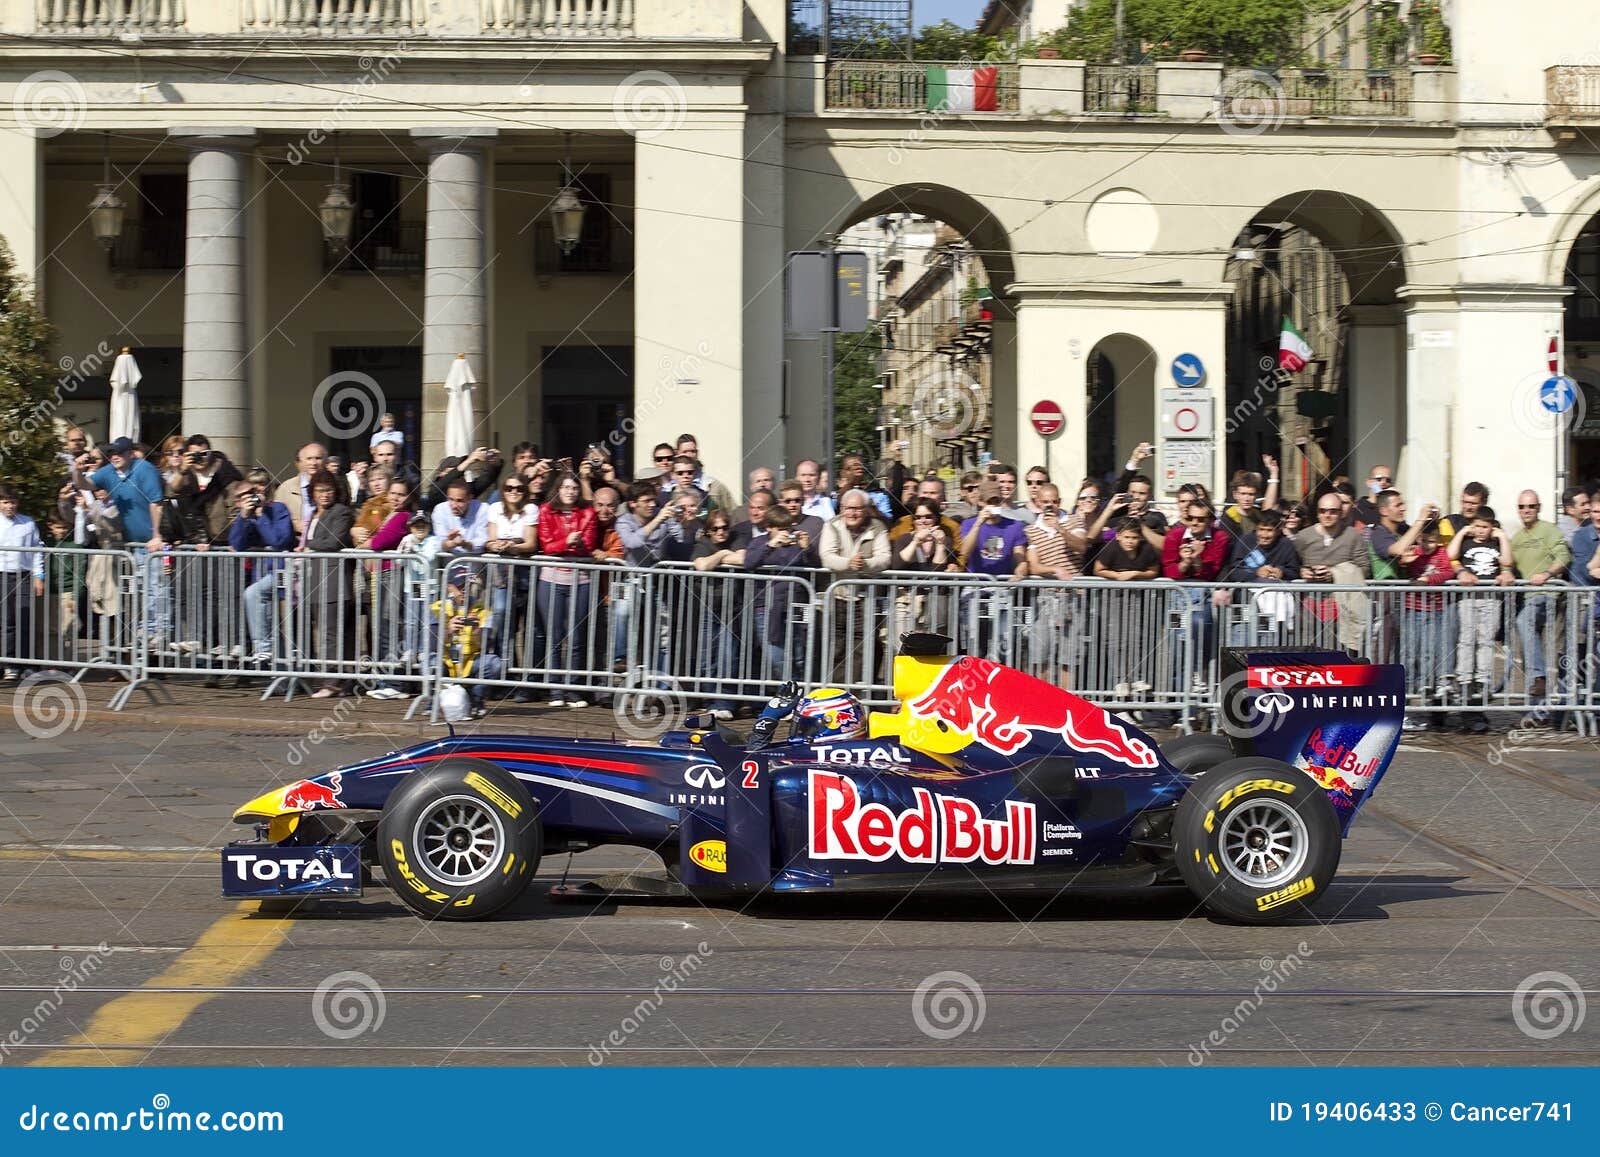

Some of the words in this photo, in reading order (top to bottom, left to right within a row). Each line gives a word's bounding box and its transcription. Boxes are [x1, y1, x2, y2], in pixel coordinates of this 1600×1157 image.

[1253, 667, 1342, 686] TOTAL
[1302, 695, 1397, 709] INFINITI
[811, 745, 911, 764] TOTAL
[1308, 727, 1343, 765] Red
[1340, 751, 1380, 778] Bull
[742, 760, 759, 789] 2
[808, 768, 937, 864] Red
[935, 792, 1037, 865] Bull
[1203, 809, 1216, 834] P
[1216, 778, 1297, 812] ZERO
[1046, 823, 1075, 831] Platform
[1041, 848, 1074, 856] SIEMENS
[227, 854, 354, 881] TOTAL
[391, 838, 450, 904] ZERO
[453, 894, 476, 907] P
[1255, 876, 1317, 912] PIRELLI
